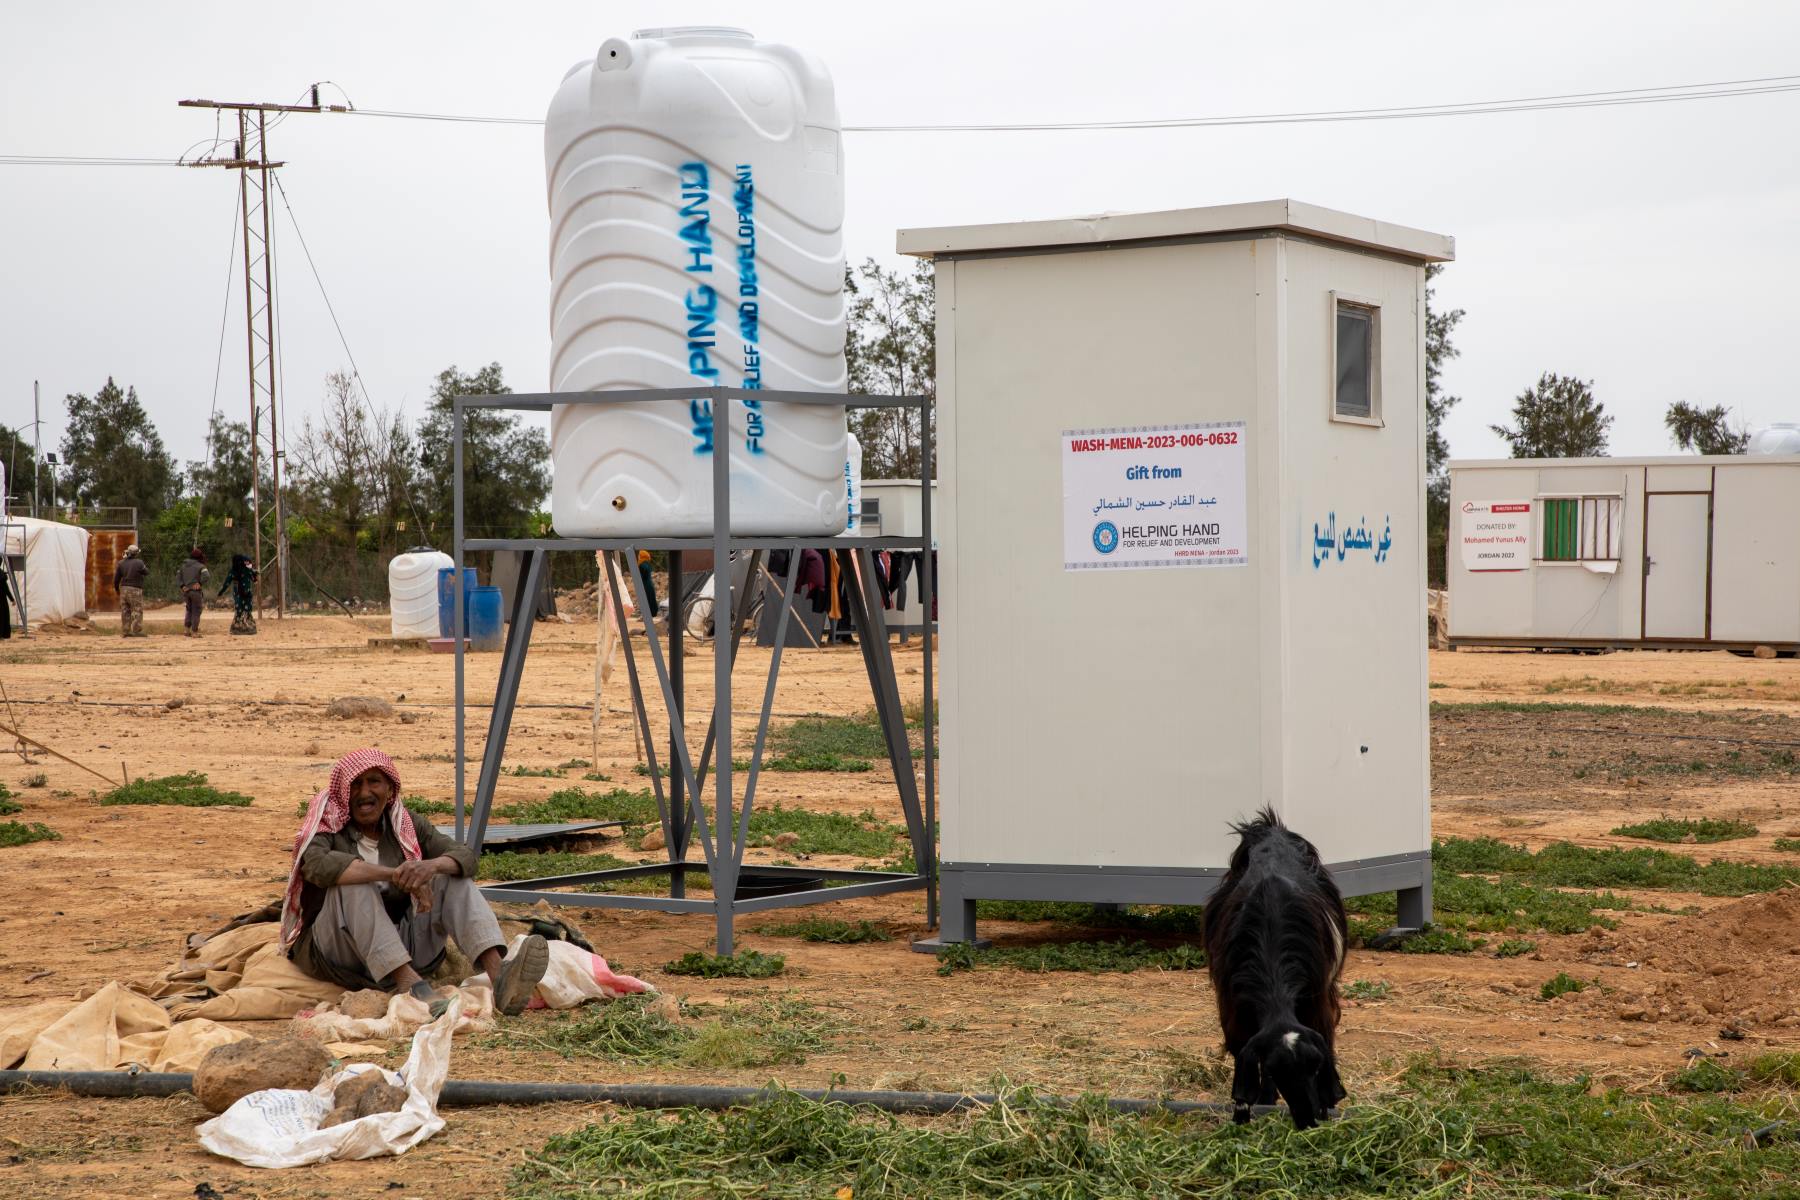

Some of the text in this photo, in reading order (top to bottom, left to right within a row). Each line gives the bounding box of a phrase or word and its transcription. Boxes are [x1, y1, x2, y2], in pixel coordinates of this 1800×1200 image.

[734, 163, 758, 297] DEVELOPMENT
[678, 162, 719, 455] HEPING HAND
[740, 301, 759, 343] AND
[747, 412, 764, 455] FOR
[1071, 432, 1238, 452] WASH-MENA-2023-006-0632
[1126, 465, 1182, 480] Gift from
[1093, 495, 1217, 516] عبد القادر حسين الشمالي
[1122, 525, 1178, 539] HELPING
[1182, 523, 1220, 537] HAND
[1123, 537, 1220, 548] FOR RELIEF AND DEVELOPMENT
